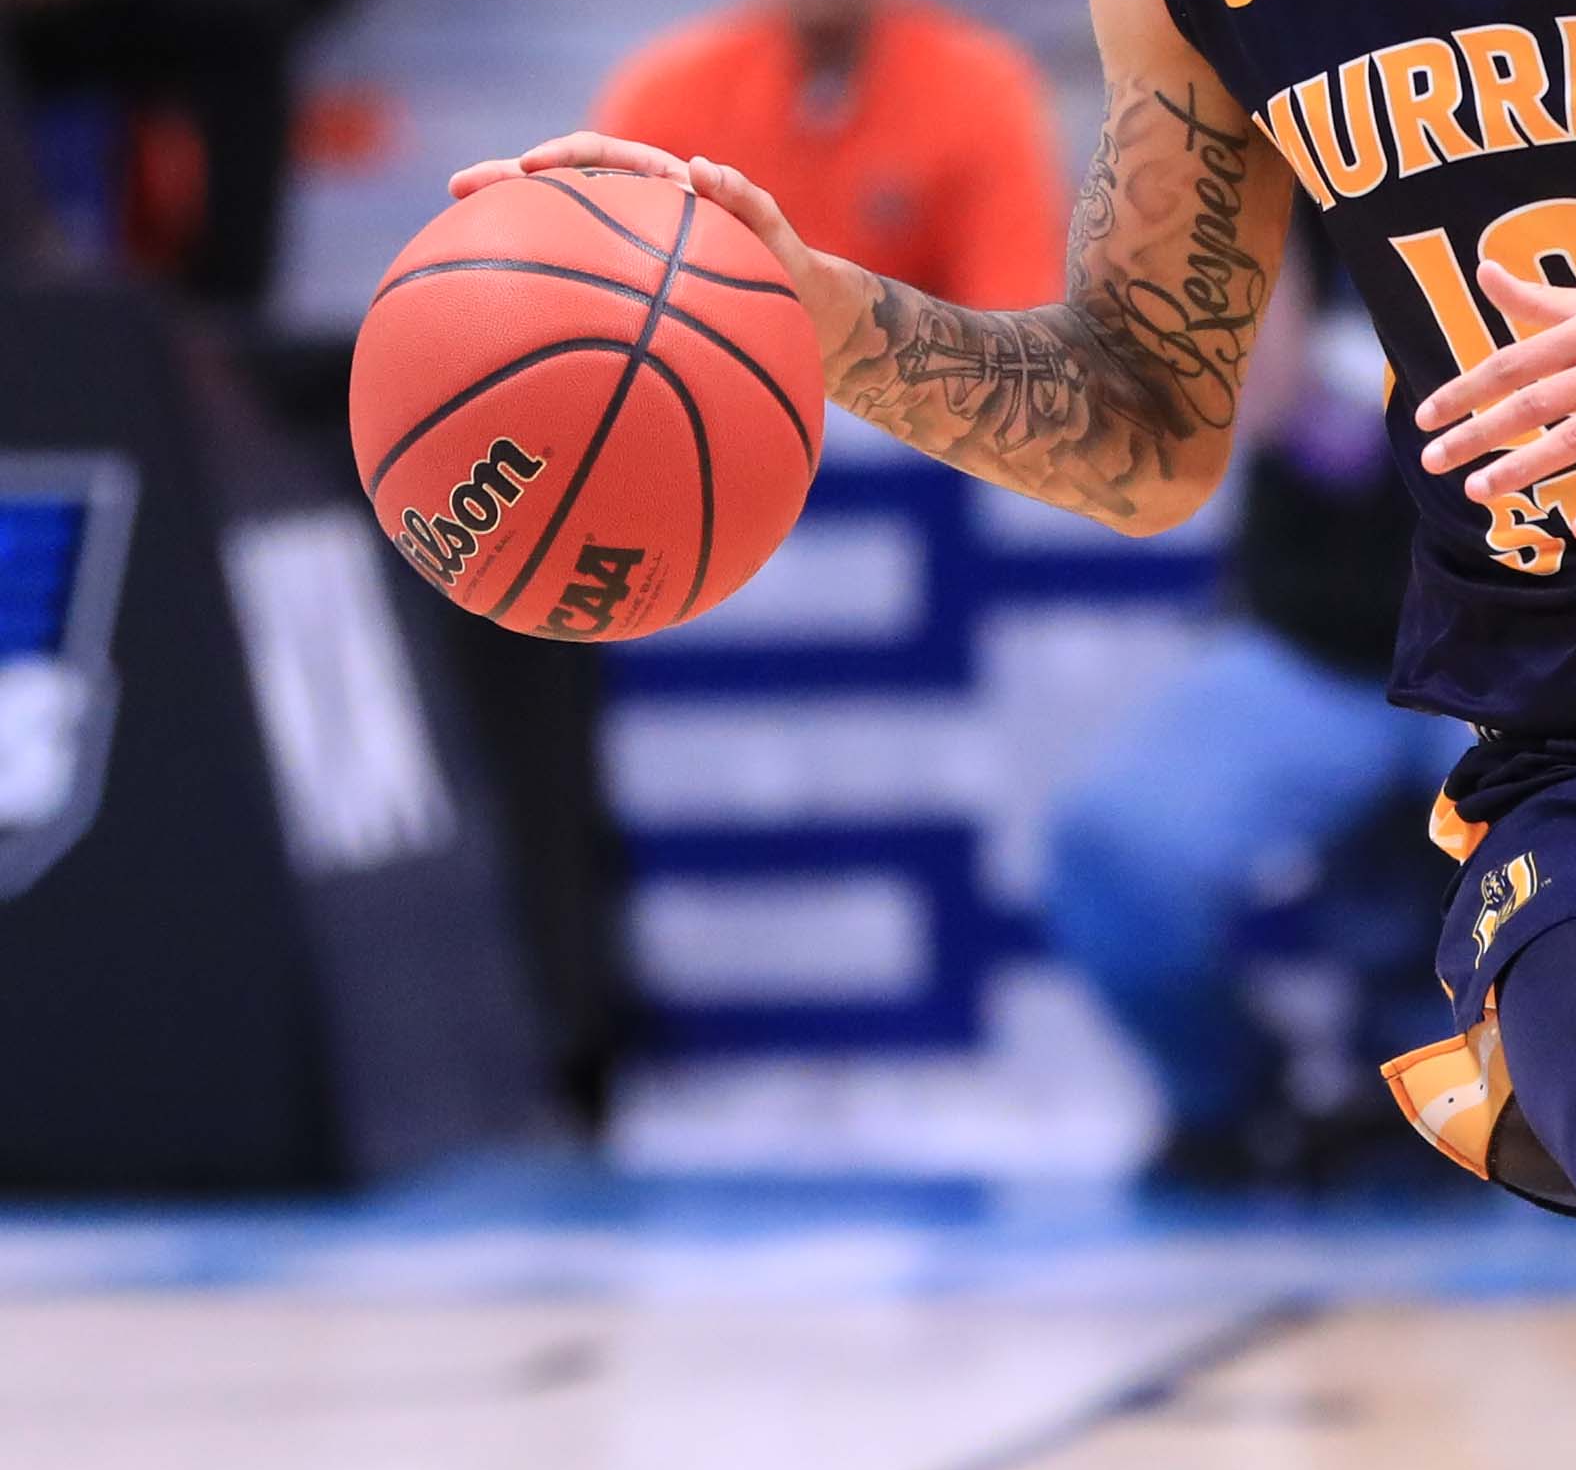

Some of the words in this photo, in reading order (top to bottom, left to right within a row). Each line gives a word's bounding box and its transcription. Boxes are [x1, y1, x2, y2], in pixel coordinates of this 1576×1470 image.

[1104, 82, 1267, 430] Respect
[394, 437, 547, 598] ilson
[534, 544, 646, 642] CAA
